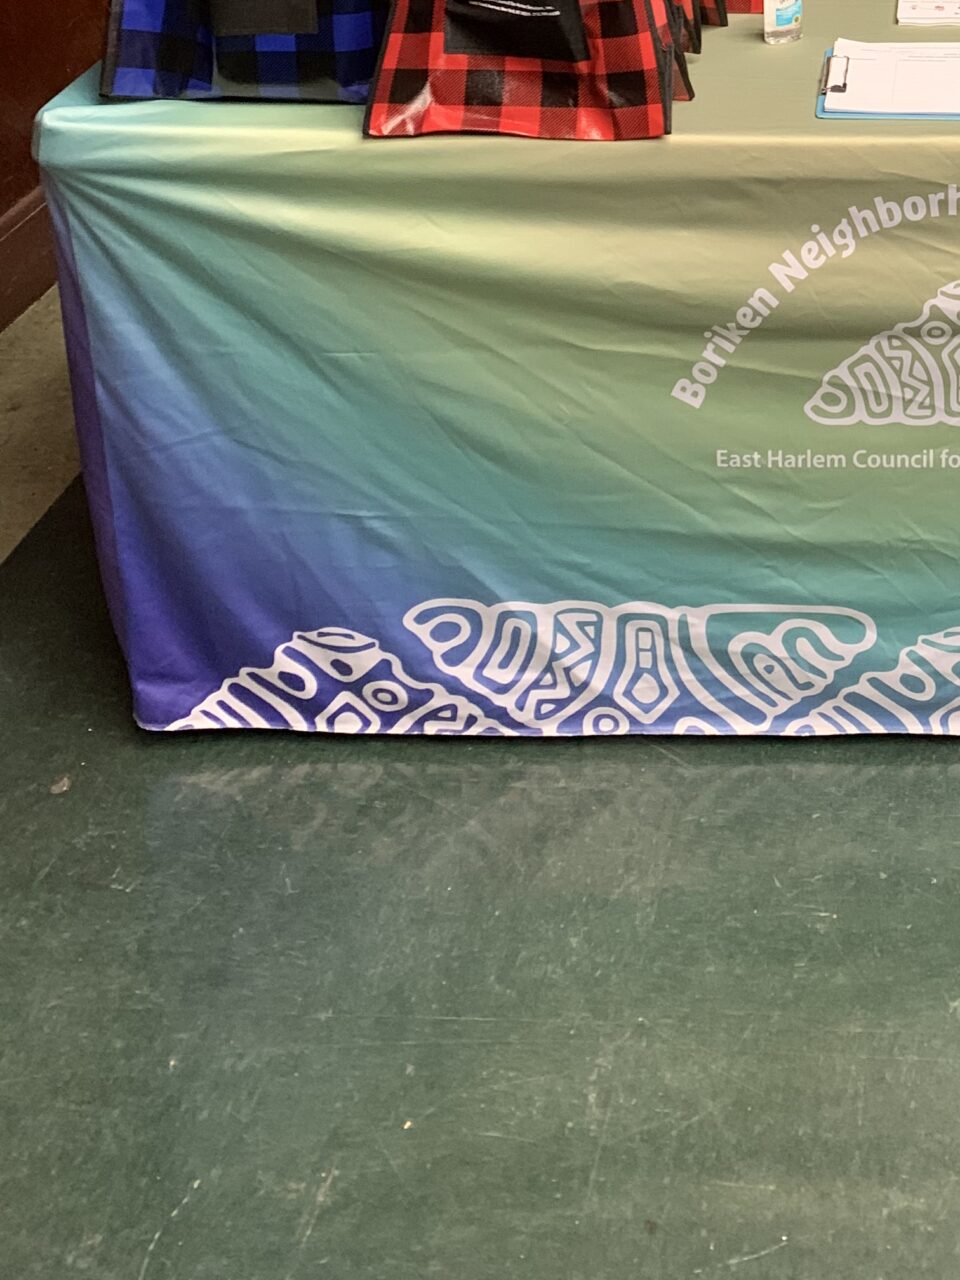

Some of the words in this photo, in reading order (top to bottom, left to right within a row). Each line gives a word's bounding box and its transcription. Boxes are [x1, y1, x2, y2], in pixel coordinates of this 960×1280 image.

[671, 286, 779, 409] Boriken
[716, 449, 762, 469] East
[766, 449, 847, 469] Harlem
[853, 449, 934, 470] Council
